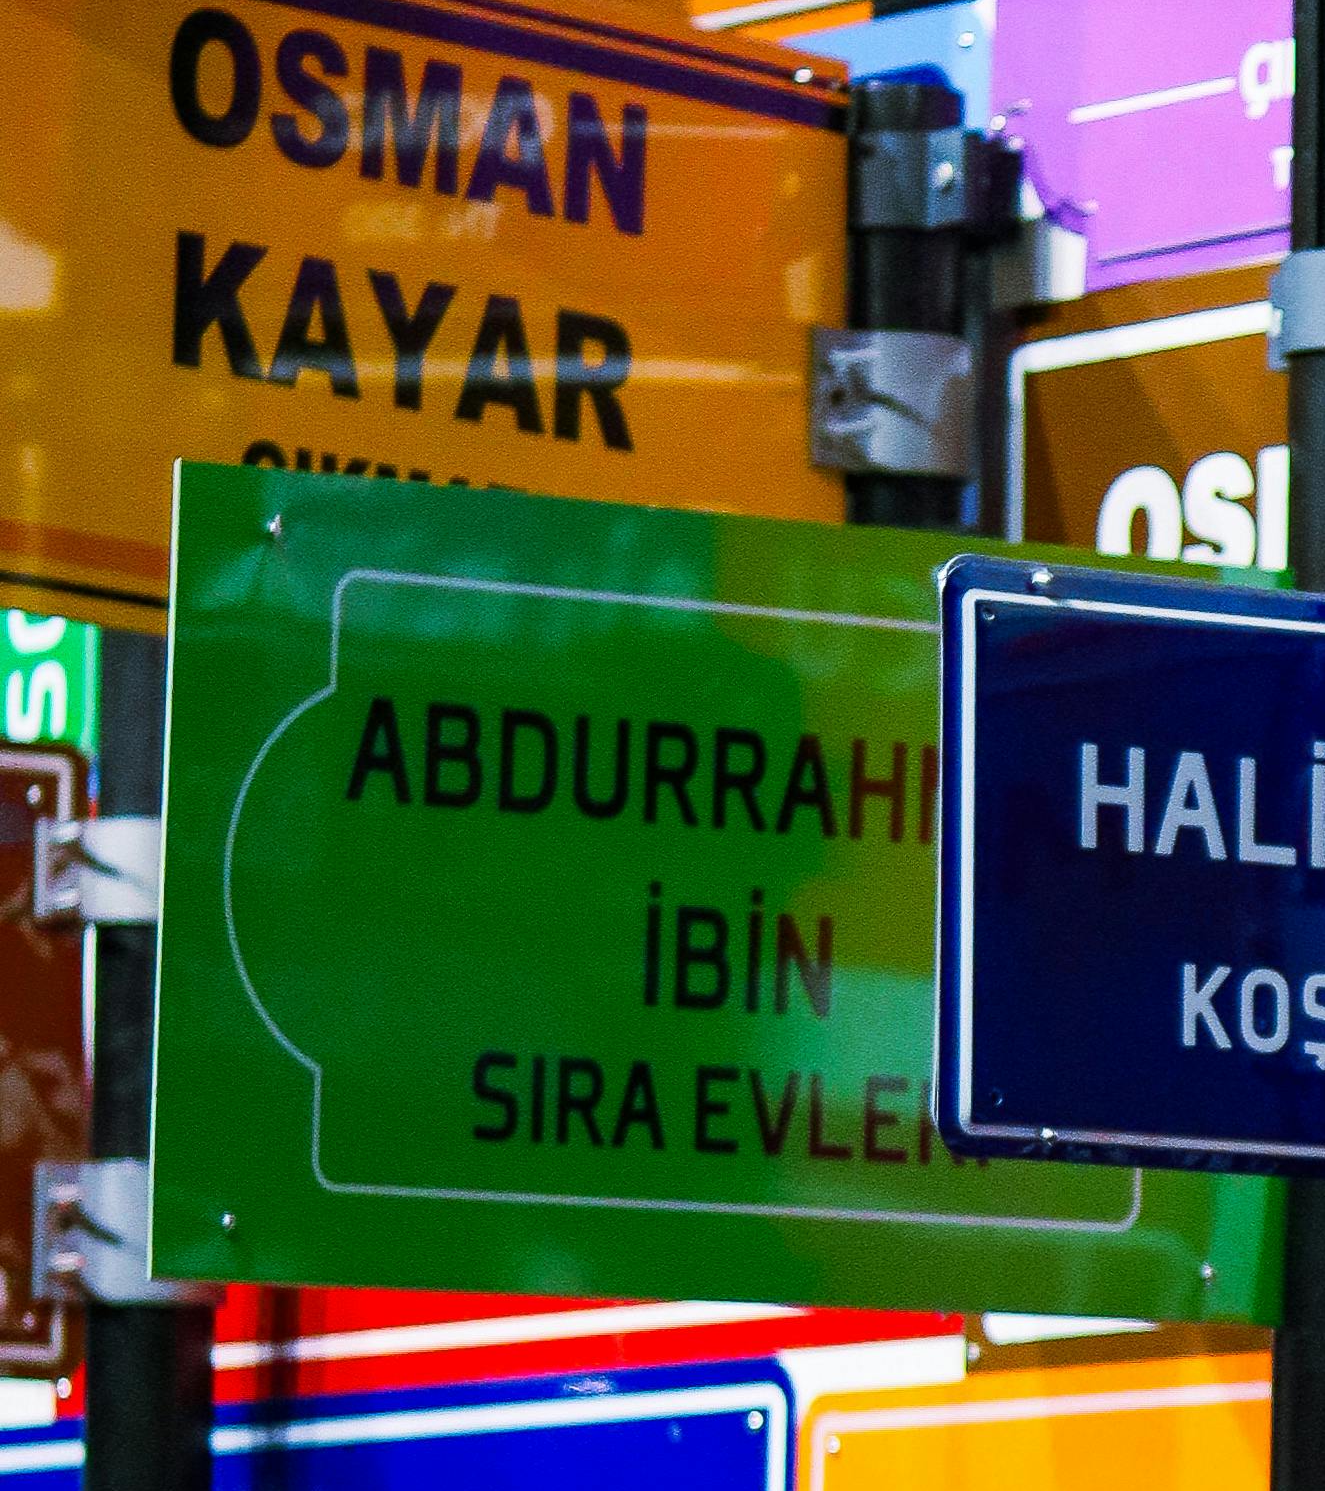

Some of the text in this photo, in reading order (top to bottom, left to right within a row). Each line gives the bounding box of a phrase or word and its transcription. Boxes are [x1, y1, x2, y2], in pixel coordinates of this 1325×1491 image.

[169, 7, 649, 238] OSMAN
[172, 230, 634, 454] KAYAR
[345, 697, 940, 845] ABDURRAH
[644, 881, 834, 1018] İBİN
[472, 1051, 667, 1152] SIRA
